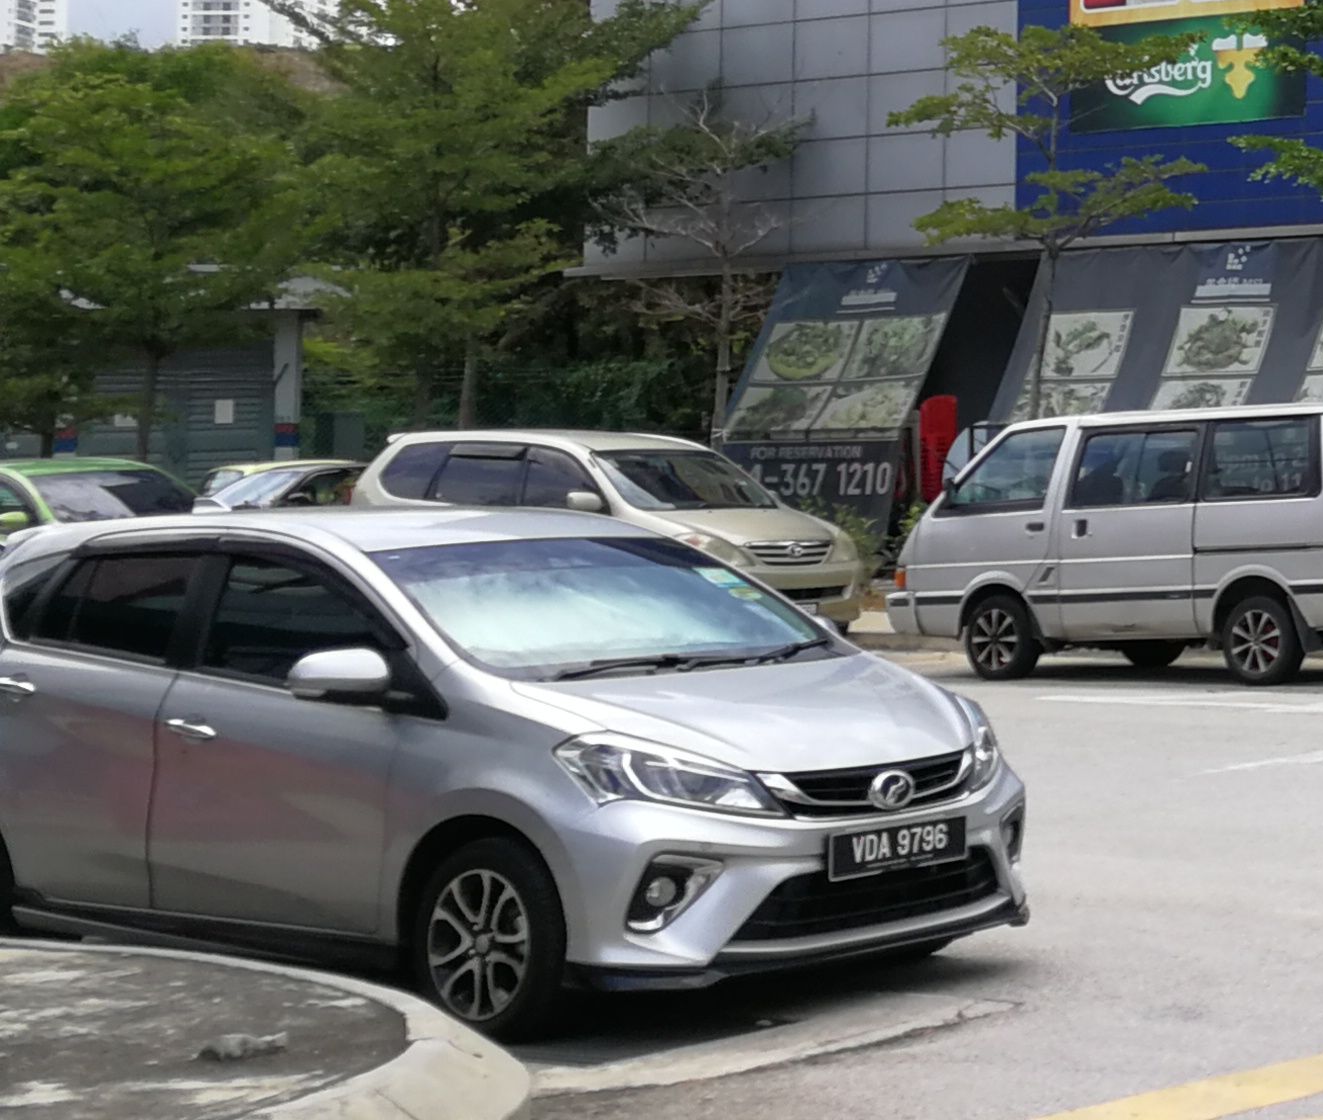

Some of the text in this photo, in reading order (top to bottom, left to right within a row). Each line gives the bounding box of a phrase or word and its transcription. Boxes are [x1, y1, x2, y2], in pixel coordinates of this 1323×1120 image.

[750, 445, 863, 459] FOR RESERVATION
[836, 461, 893, 497] 1210
[852, 822, 949, 864] VDA 9796
